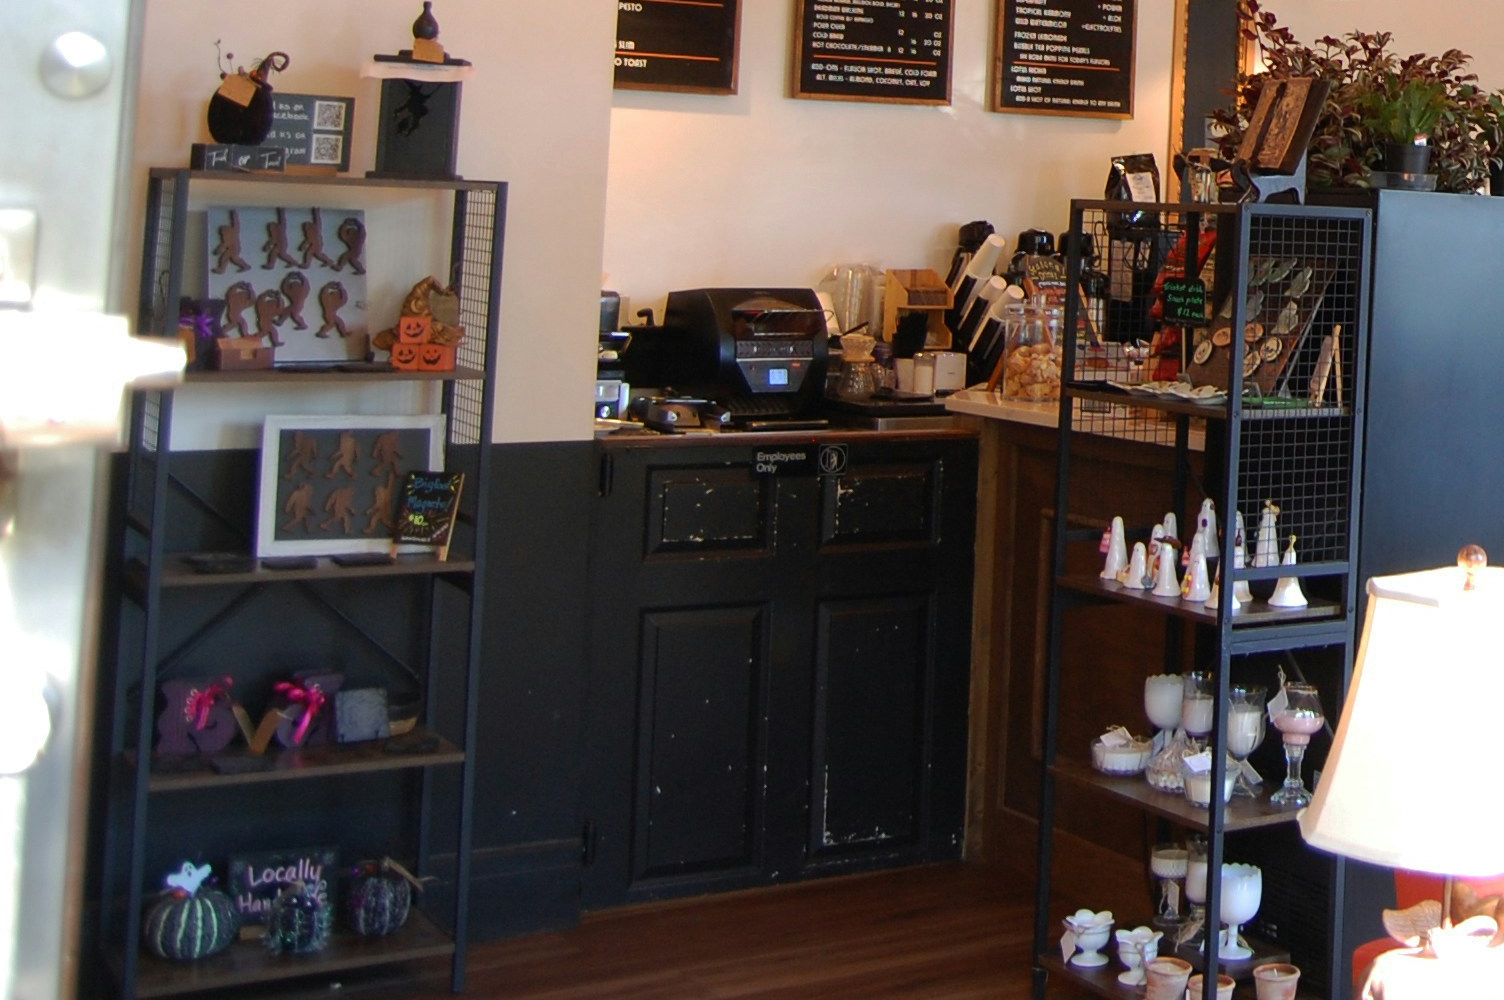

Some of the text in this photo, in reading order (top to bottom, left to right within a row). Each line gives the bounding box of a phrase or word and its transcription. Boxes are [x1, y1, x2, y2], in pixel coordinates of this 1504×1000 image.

[619, 2, 643, 12] PESTO
[757, 452, 806, 463] Employees
[756, 463, 777, 474] Only
[247, 858, 323, 890] Locally
